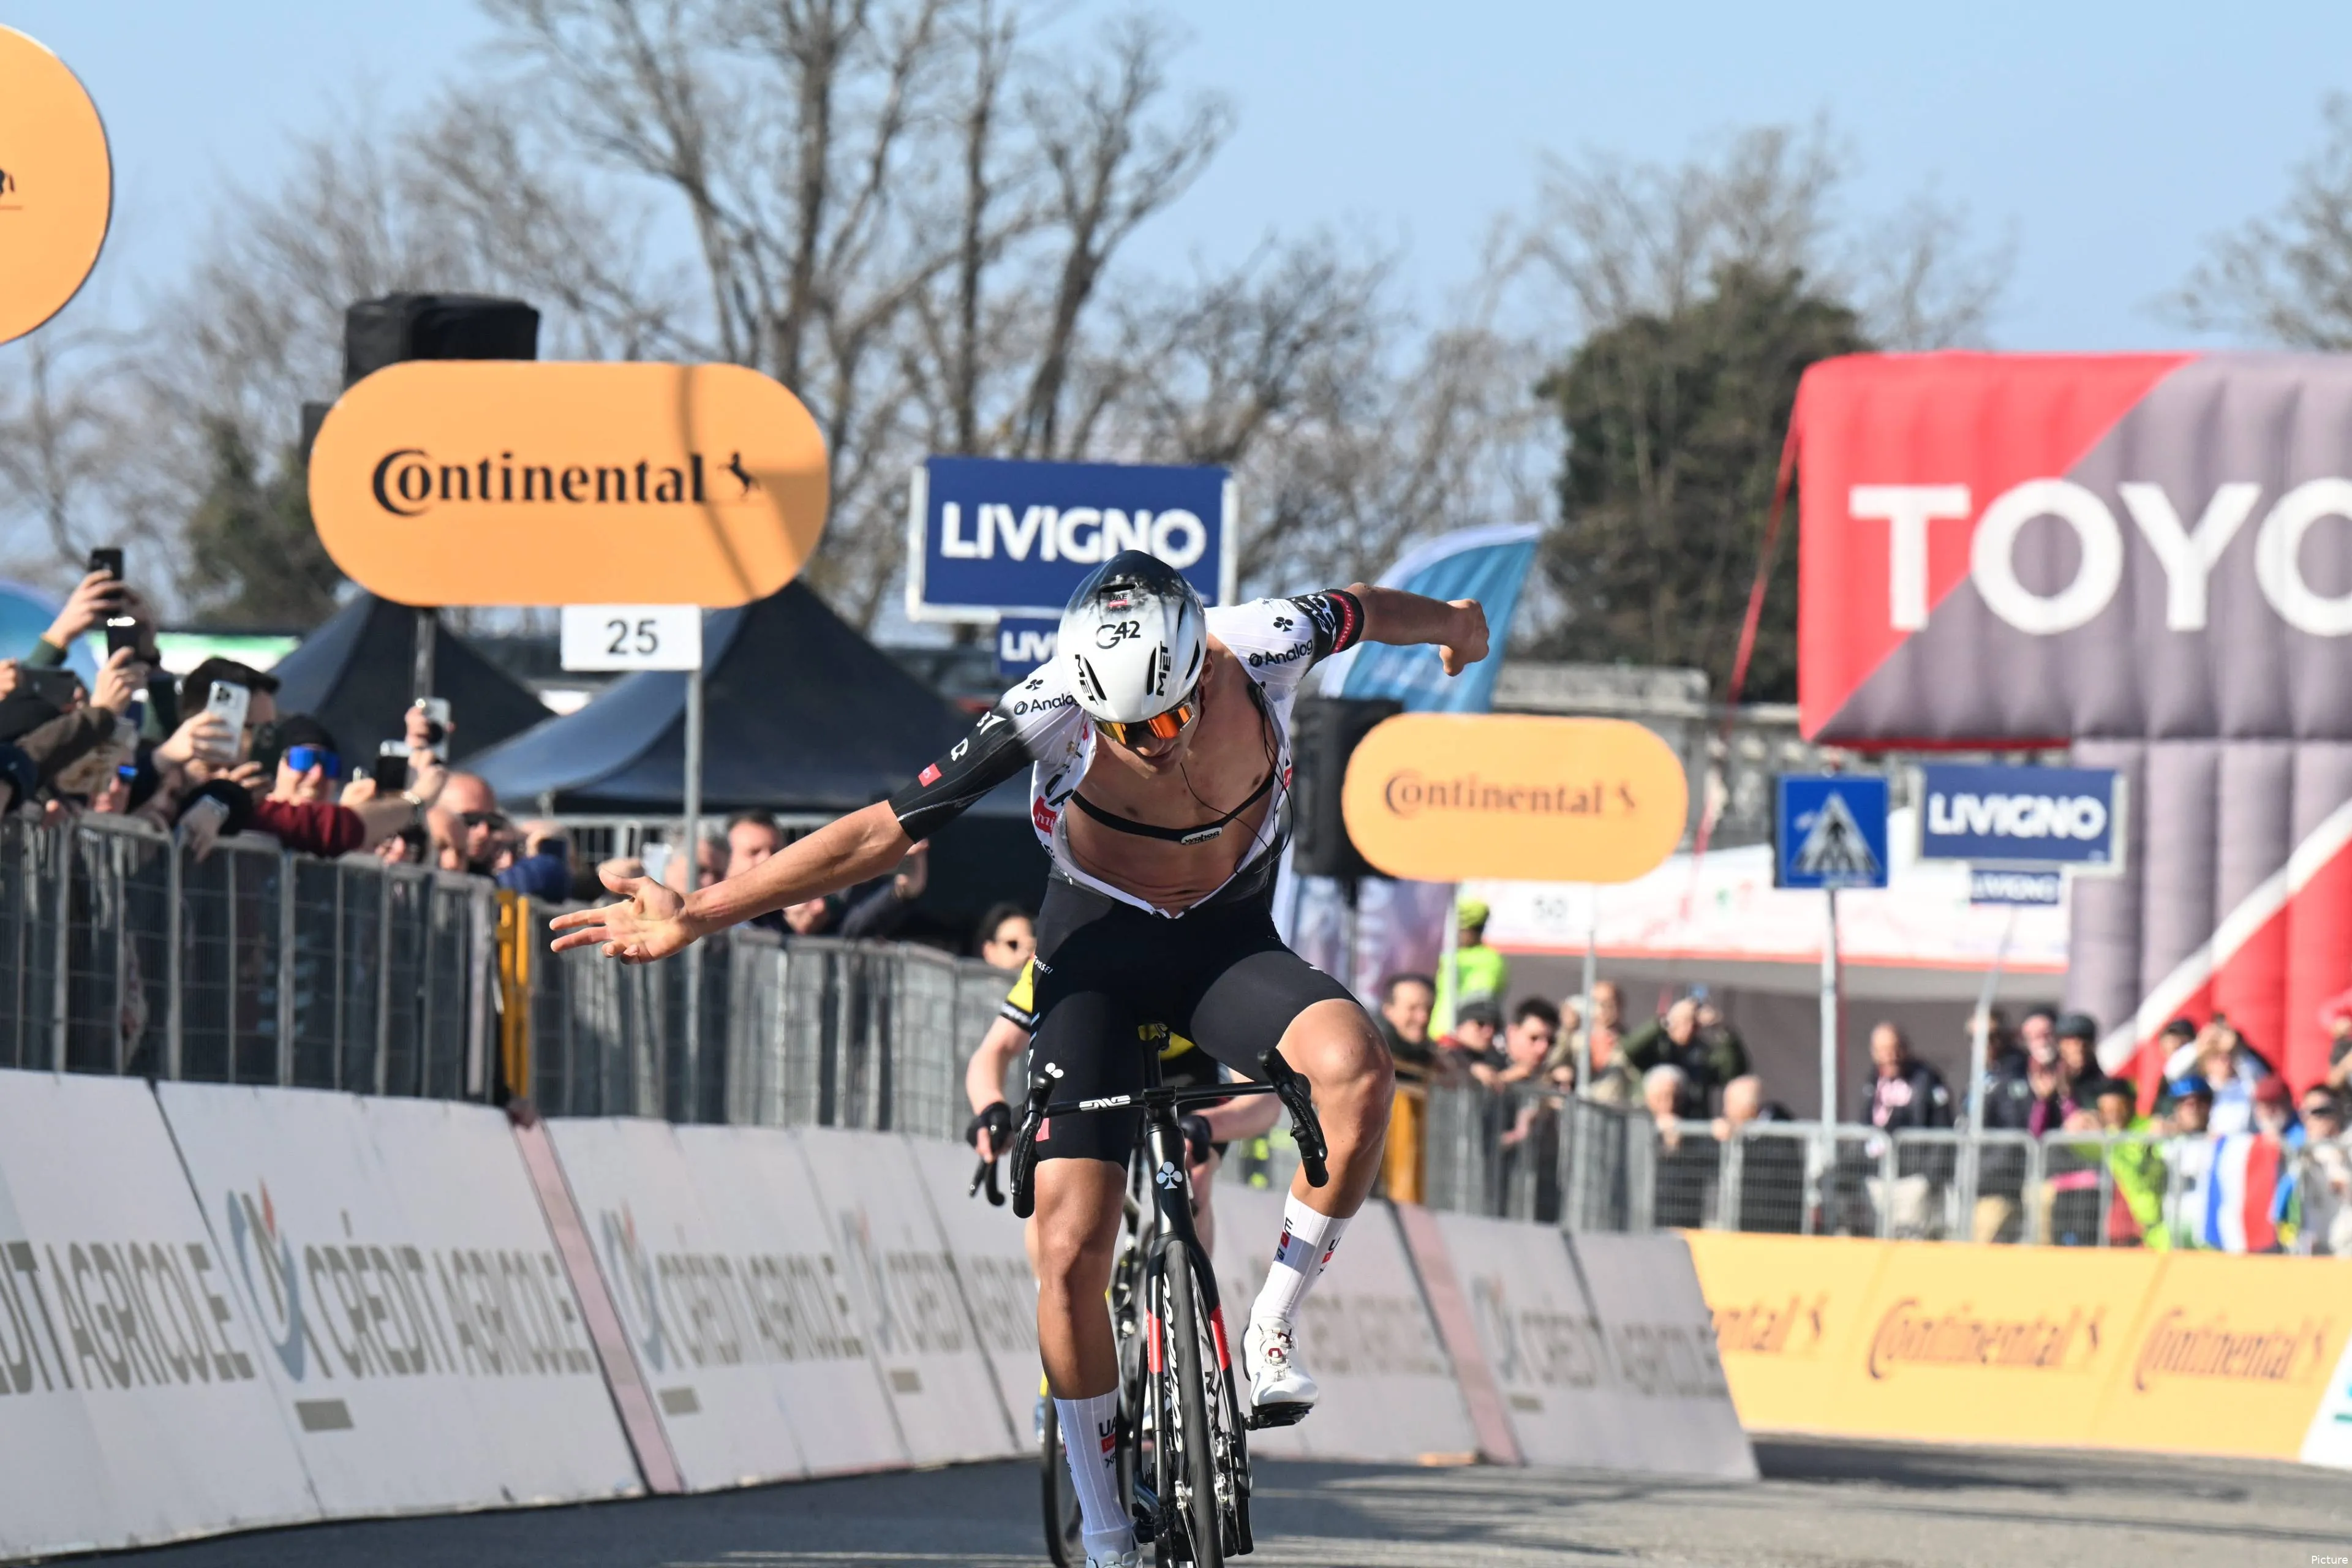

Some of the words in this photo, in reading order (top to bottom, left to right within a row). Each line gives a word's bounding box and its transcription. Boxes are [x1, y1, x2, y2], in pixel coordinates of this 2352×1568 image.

[372, 448, 706, 516] Continental
[941, 501, 1207, 570] LIVIGNO
[606, 619, 659, 655] 25
[1096, 620, 1141, 649] G42
[1265, 639, 1314, 665] Analog
[1074, 654, 1099, 706] MET
[1156, 640, 1171, 696] MET
[1030, 693, 1080, 713] Analo
[1384, 774, 1604, 816] Continental
[1928, 792, 2108, 840] LIVIGNO
[45, 1241, 256, 1394] AGRICOLE
[1868, 1297, 2082, 1380] Continental
[2134, 1306, 2315, 1392] Continental
